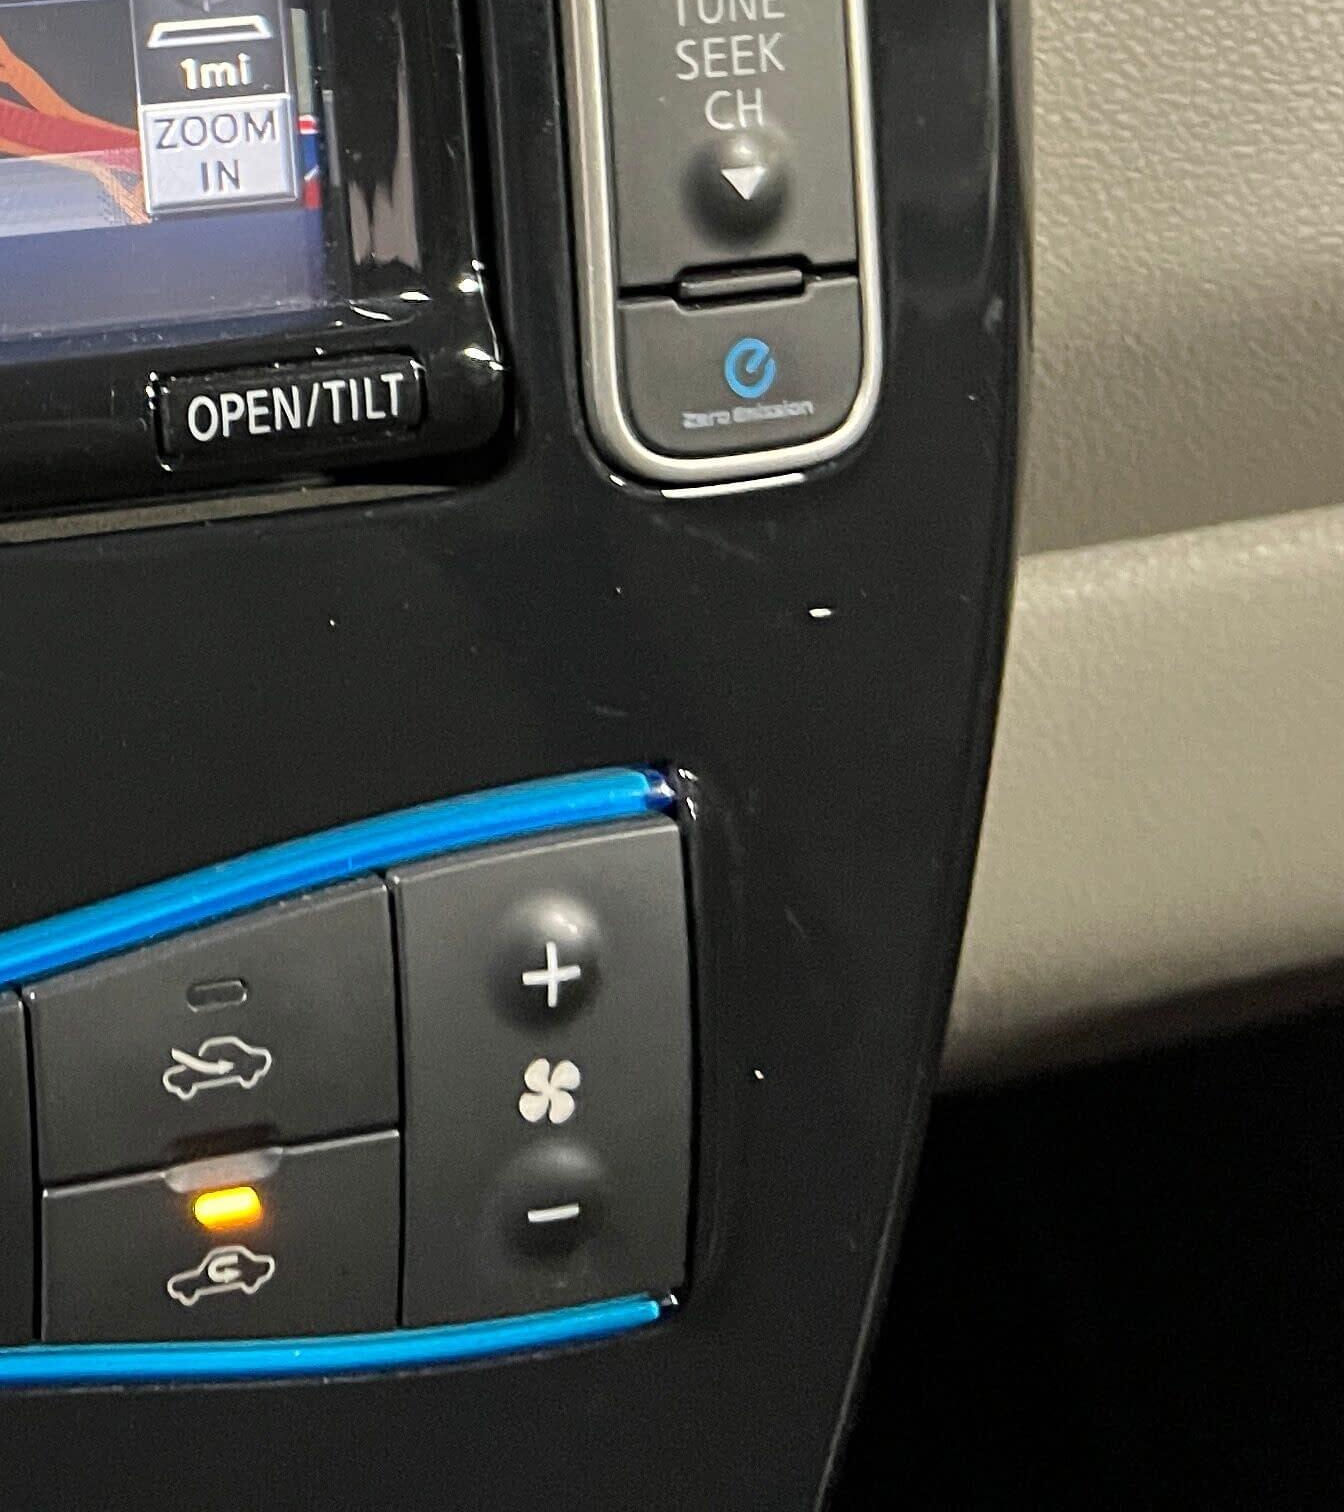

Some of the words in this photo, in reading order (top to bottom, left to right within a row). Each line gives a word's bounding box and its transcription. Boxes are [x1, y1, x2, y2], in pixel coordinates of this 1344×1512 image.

[180, 52, 252, 90] 1mi
[675, 33, 785, 81] SEEK
[705, 90, 764, 131] CH
[153, 112, 278, 150] ZOOM
[201, 159, 241, 192] IN
[187, 372, 404, 442] OPEN/TILT
